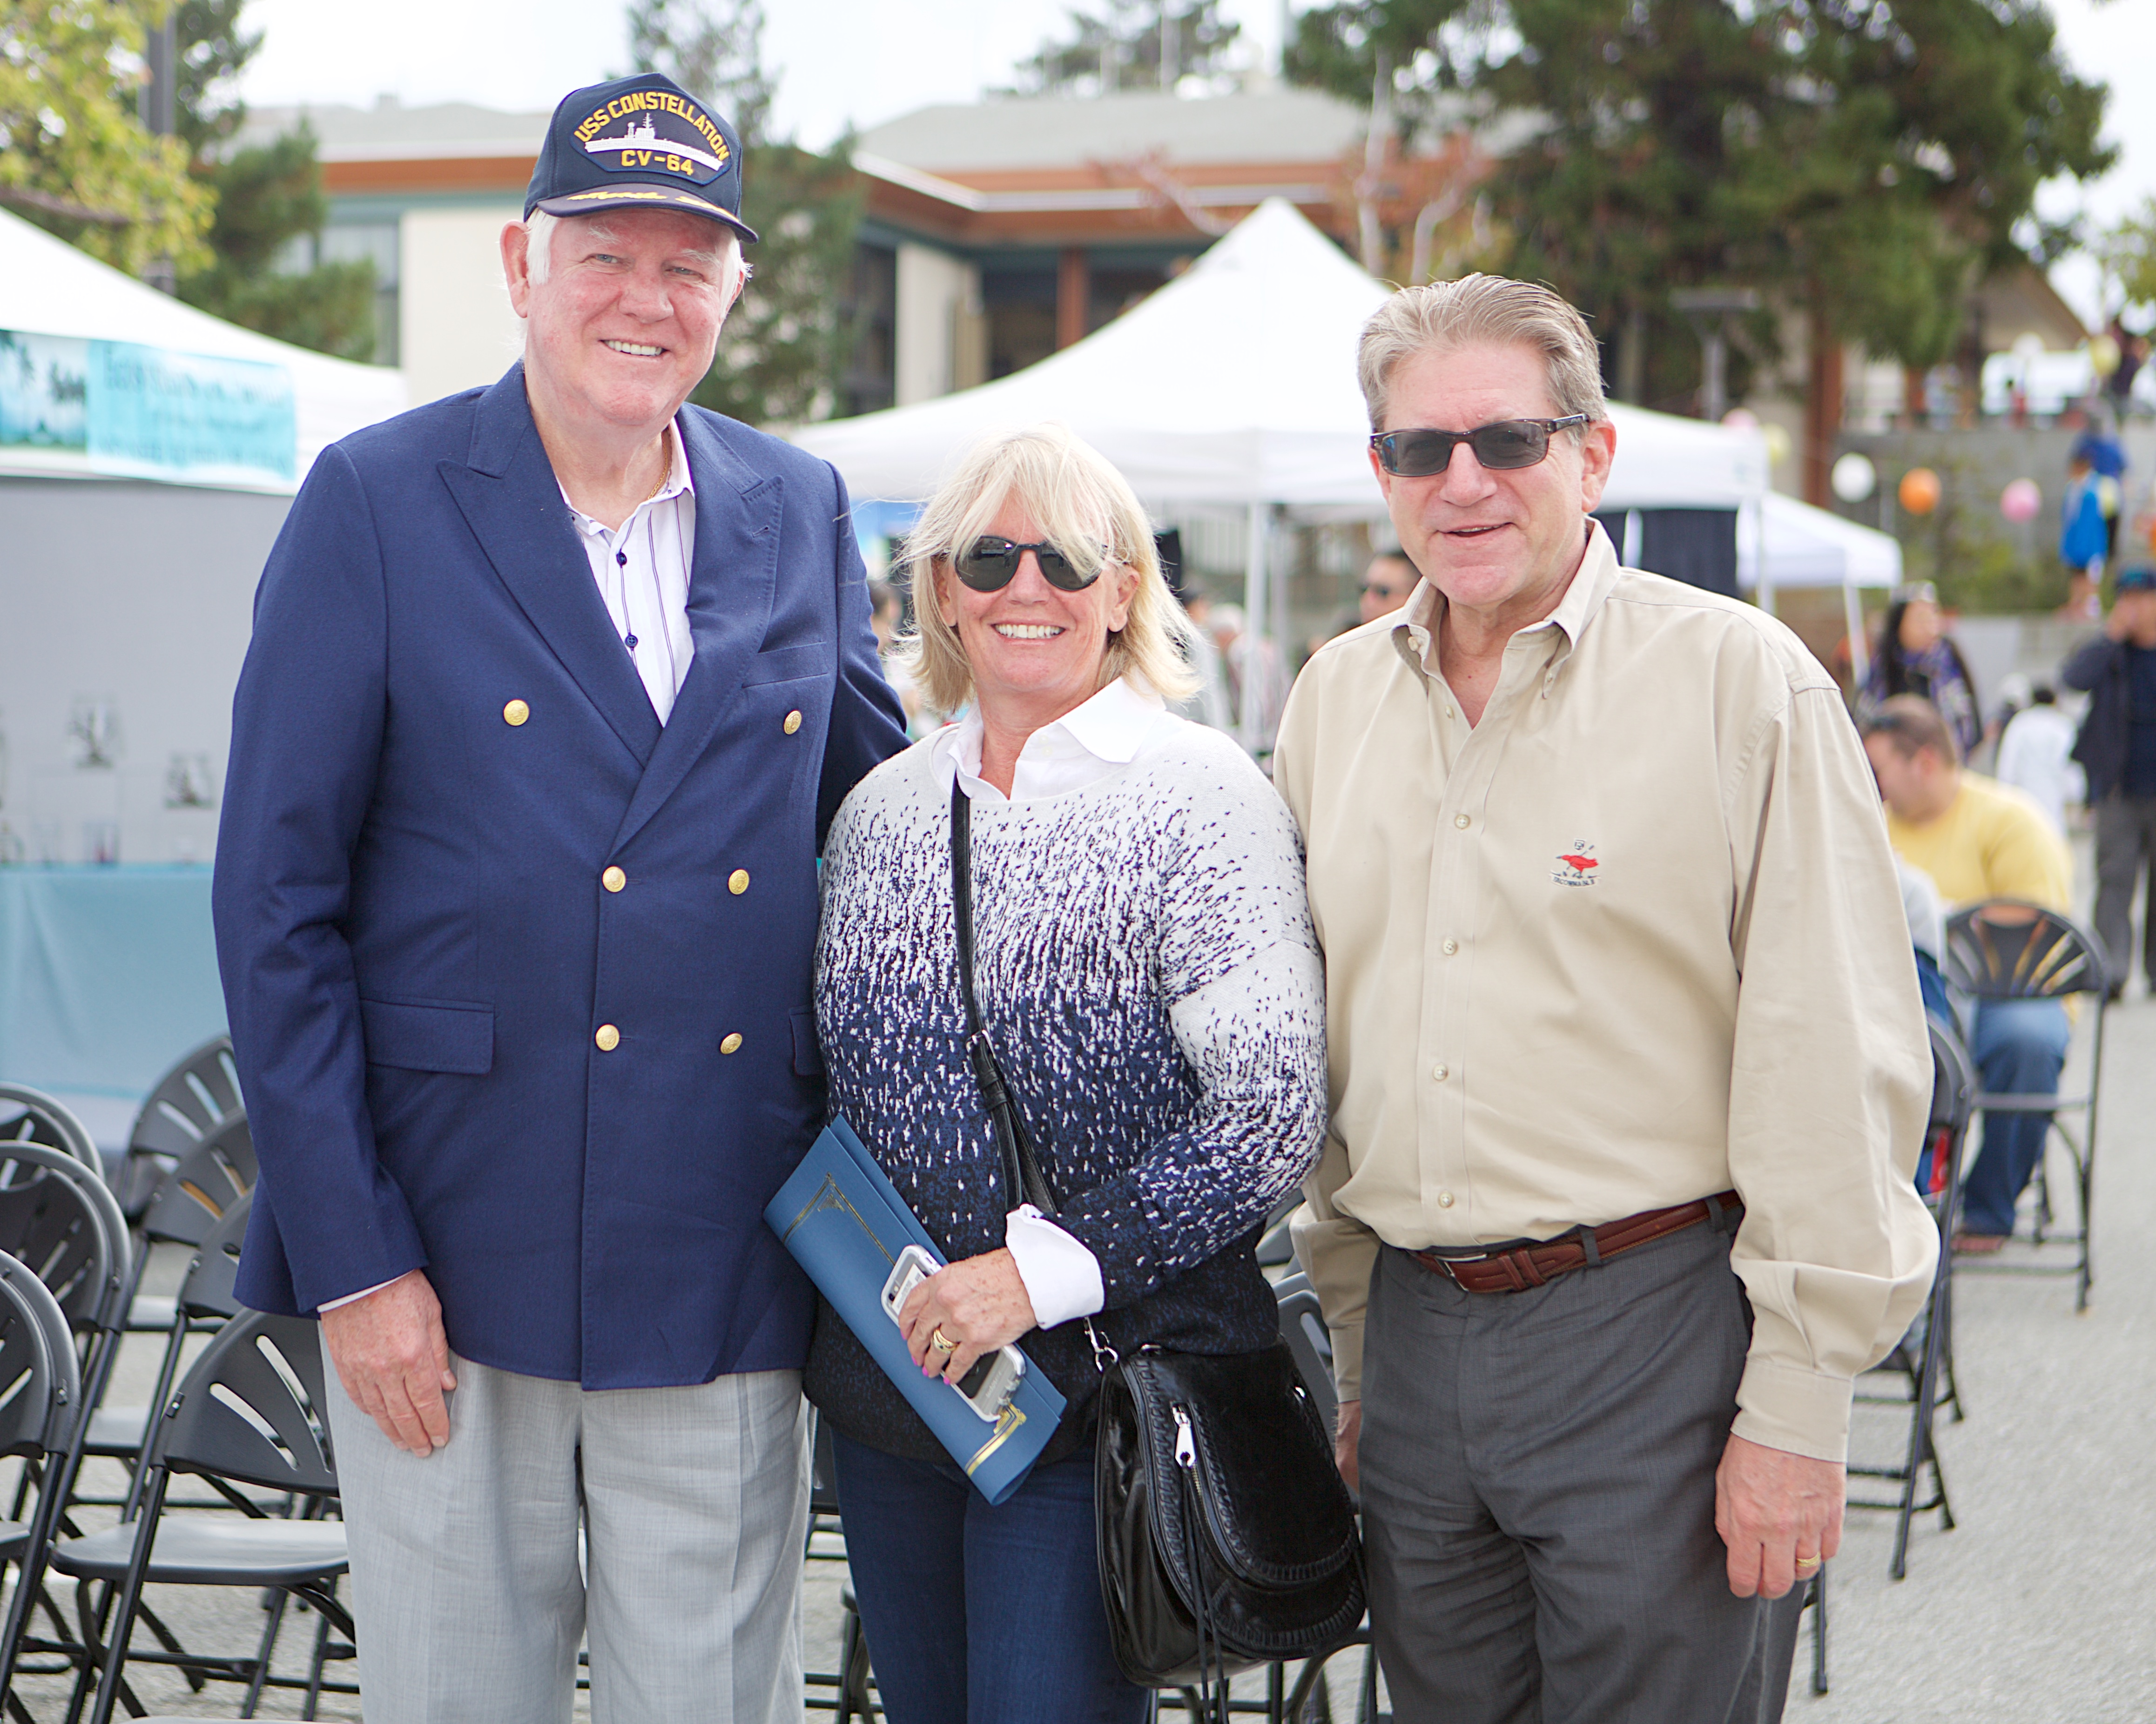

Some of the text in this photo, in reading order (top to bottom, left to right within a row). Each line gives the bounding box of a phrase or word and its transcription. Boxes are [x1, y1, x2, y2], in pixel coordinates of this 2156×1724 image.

[574, 92, 729, 161] USS CONSTELLATION
[621, 150, 694, 175] CV-64
